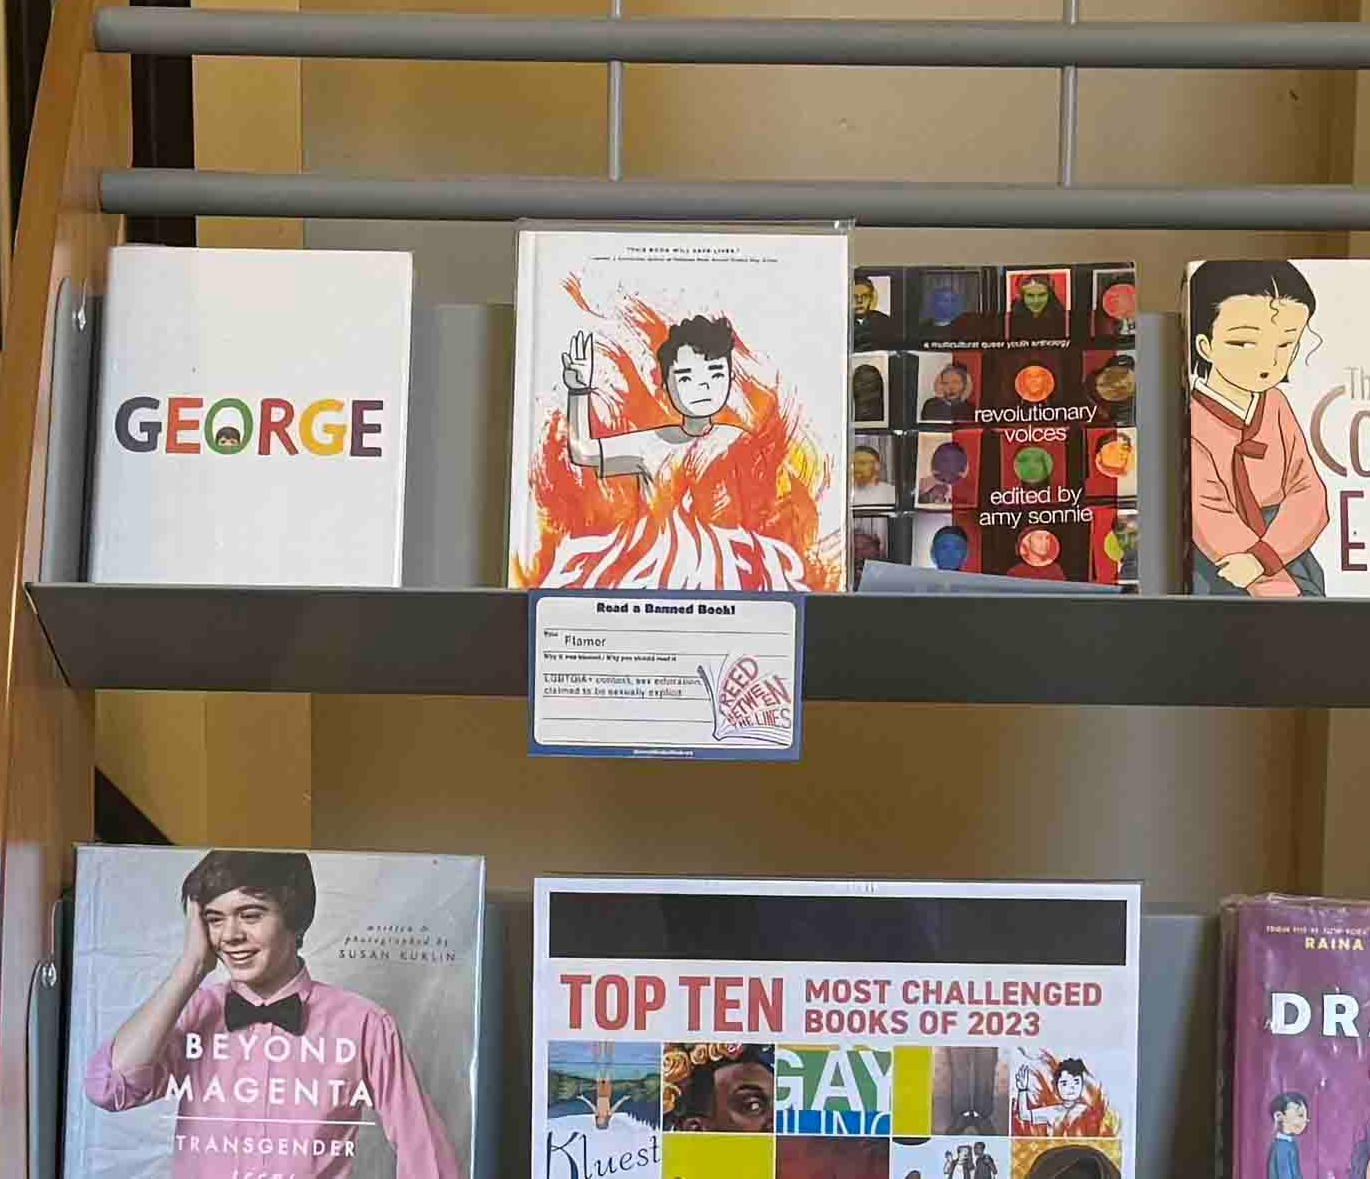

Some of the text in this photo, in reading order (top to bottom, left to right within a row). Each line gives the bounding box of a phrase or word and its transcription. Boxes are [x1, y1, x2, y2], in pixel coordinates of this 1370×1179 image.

[974, 403, 1097, 422] revolutionary
[115, 397, 384, 458] GEORGE
[1004, 426, 1067, 442] voices
[990, 486, 1083, 505] edited by
[979, 505, 1094, 529] amy sonnie
[596, 602, 628, 614] Read
[338, 949, 456, 961] SUSAN KUKLIN
[1305, 937, 1364, 951] RAINA
[559, 974, 1102, 1032] TOP TEN MOST CHALLENGED
[805, 1010, 1041, 1036] BOOKS OF 2023
[185, 1033, 358, 1064] BEYOND
[164, 1074, 374, 1108] MAGENTA
[775, 1048, 893, 1111] GAY
[175, 1134, 356, 1156] TRANSGENDER
